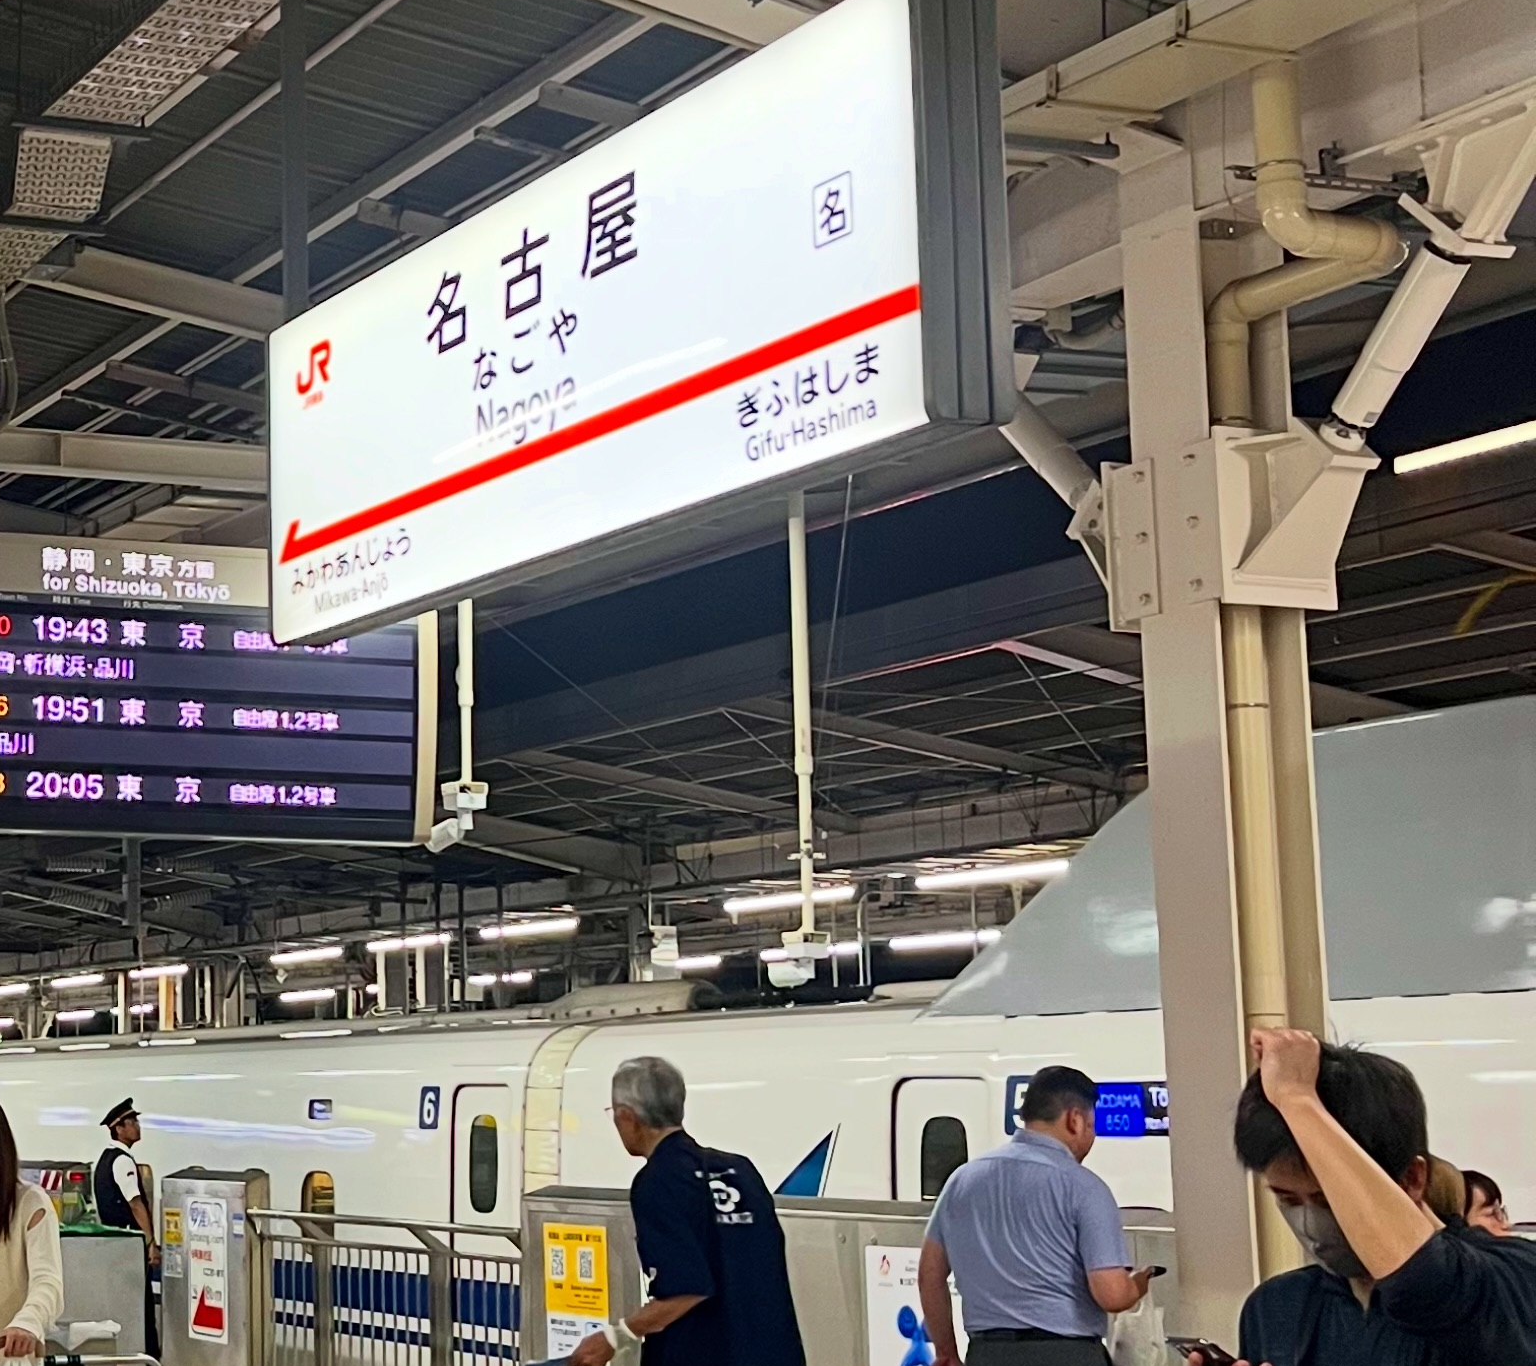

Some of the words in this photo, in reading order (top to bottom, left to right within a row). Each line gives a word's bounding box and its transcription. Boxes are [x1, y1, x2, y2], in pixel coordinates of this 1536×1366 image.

[820, 187, 846, 235] 名
[426, 169, 639, 355] 名古屋
[296, 339, 330, 395] JR
[473, 307, 579, 391] なごや
[476, 376, 577, 447] Nagoya
[736, 343, 880, 428] ぎふはしま
[745, 398, 878, 461] Gifu-Hashima
[42, 572, 70, 591] for
[75, 574, 168, 600] Shizuoka,
[173, 579, 232, 603] Tōkyō
[291, 528, 412, 595] みかわあんじょう
[32, 614, 108, 645] 19:43
[32, 695, 105, 723] 19:51
[26, 770, 104, 801] 20:05
[423, 1091, 436, 1125] 6
